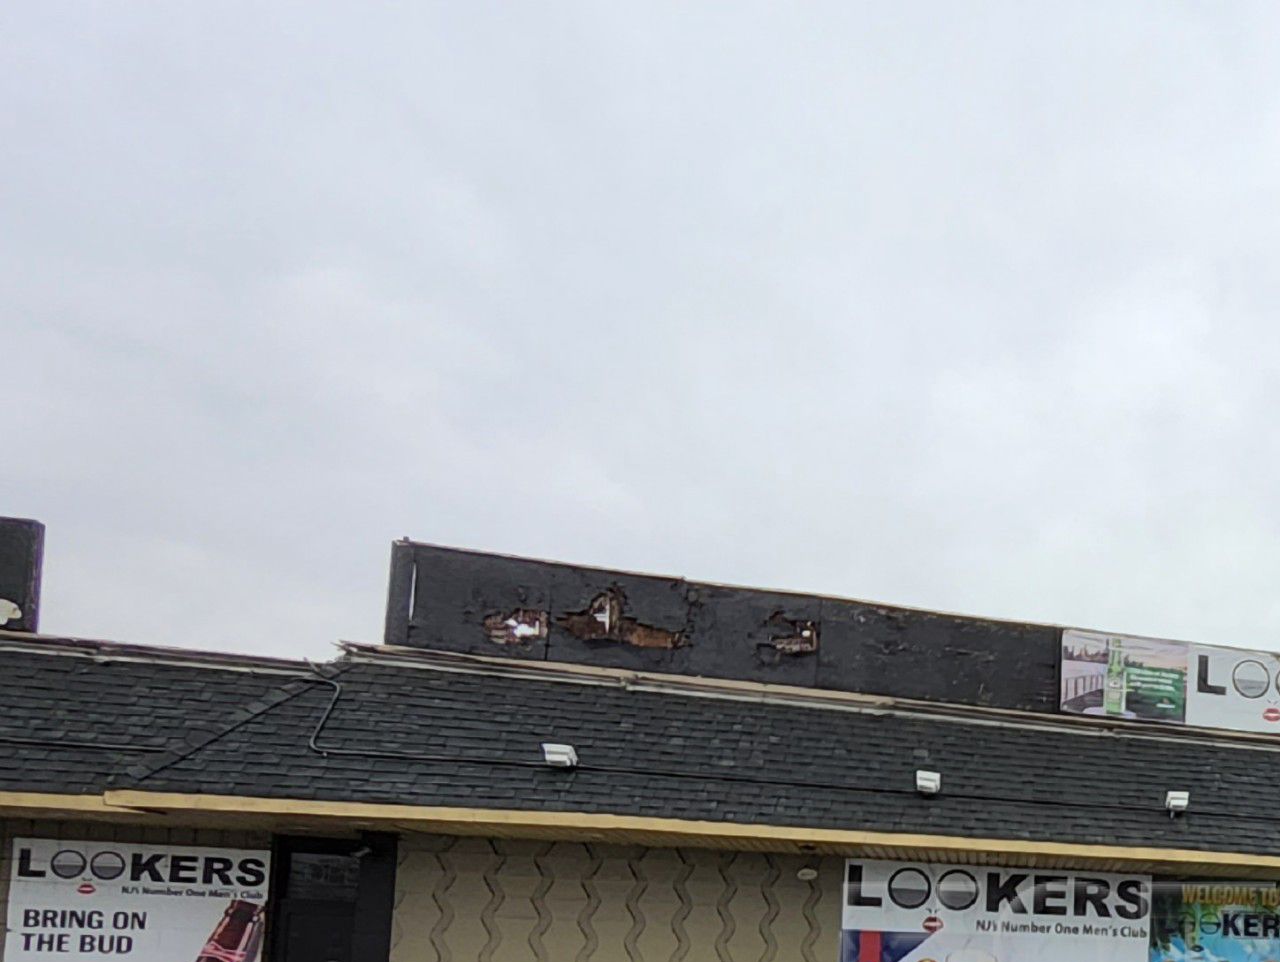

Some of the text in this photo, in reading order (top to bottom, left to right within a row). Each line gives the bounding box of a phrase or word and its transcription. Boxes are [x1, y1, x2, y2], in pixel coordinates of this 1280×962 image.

[17, 848, 266, 887] LOOKERS
[142, 887, 183, 896] Number
[186, 889, 206, 897] One
[208, 889, 237, 898] Men's
[240, 891, 263, 899] Club
[848, 864, 1149, 920] LOOKERS
[1182, 884, 1257, 906] WELCOME
[23, 908, 147, 930] BRING ON
[1001, 920, 1051, 934] Number
[1055, 922, 1079, 935] One
[1082, 924, 1118, 937] Men's
[1120, 926, 1147, 938] Club
[20, 932, 133, 954] THE BUD
